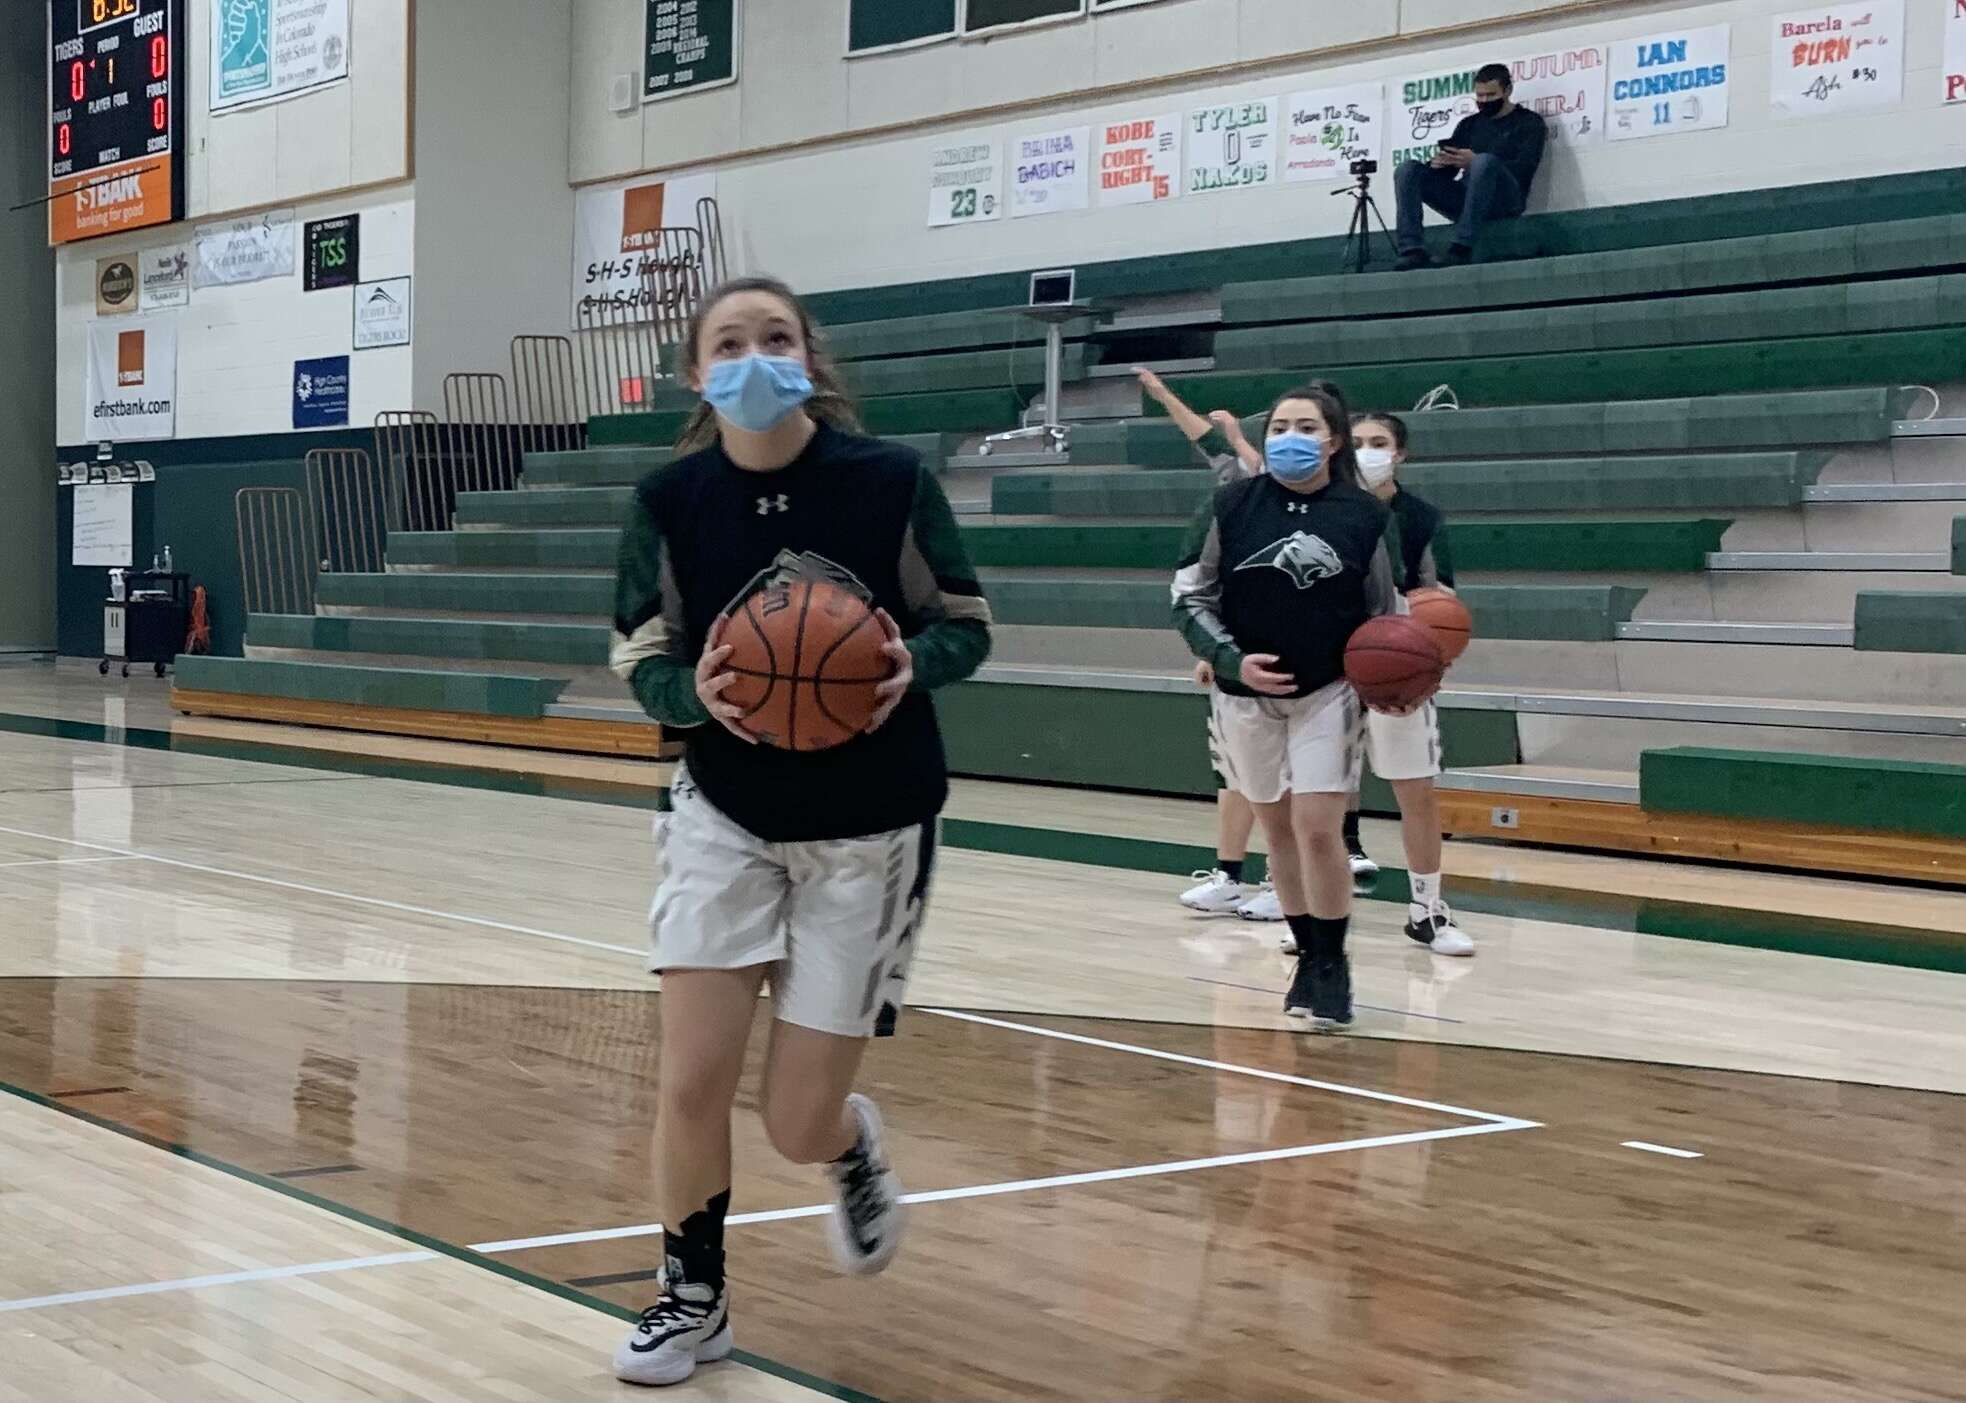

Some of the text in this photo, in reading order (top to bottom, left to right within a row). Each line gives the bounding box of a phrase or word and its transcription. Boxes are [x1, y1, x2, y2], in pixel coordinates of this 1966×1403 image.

[133, 10, 164, 38] GUEST
[54, 37, 84, 62] TIGERS
[97, 35, 119, 54] PERIOD
[152, 36, 165, 78] 0
[676, 47, 706, 64] CHAMPS
[1637, 40, 1687, 68] IAN
[1792, 36, 1852, 67] BURN
[72, 61, 84, 101] 0
[108, 58, 114, 84] 1
[1613, 64, 1726, 101] CONNORS
[146, 80, 167, 98] FOULS
[1946, 74, 1966, 100] P
[88, 92, 129, 114] PLAYER FOUL
[154, 97, 165, 130] 0
[1292, 109, 1320, 126] Have
[1323, 105, 1342, 120] No
[1193, 103, 1267, 133] TYLER
[1408, 104, 1453, 141] Tigers
[60, 123, 70, 154] 0
[147, 134, 168, 152] SCORE
[1106, 120, 1154, 145] KOBE
[1347, 127, 1359, 142] Is
[98, 147, 120, 163] MATCH
[1340, 146, 1369, 160] Here
[54, 159, 72, 175] SCORE
[1101, 166, 1154, 189] RIGHT
[1191, 162, 1267, 191] NAKOS
[1152, 175, 1169, 199] 15
[77, 201, 144, 229] banking for good
[951, 188, 976, 218] 23
[319, 238, 347, 268] TSS
[93, 398, 171, 418] efirstbank.com
